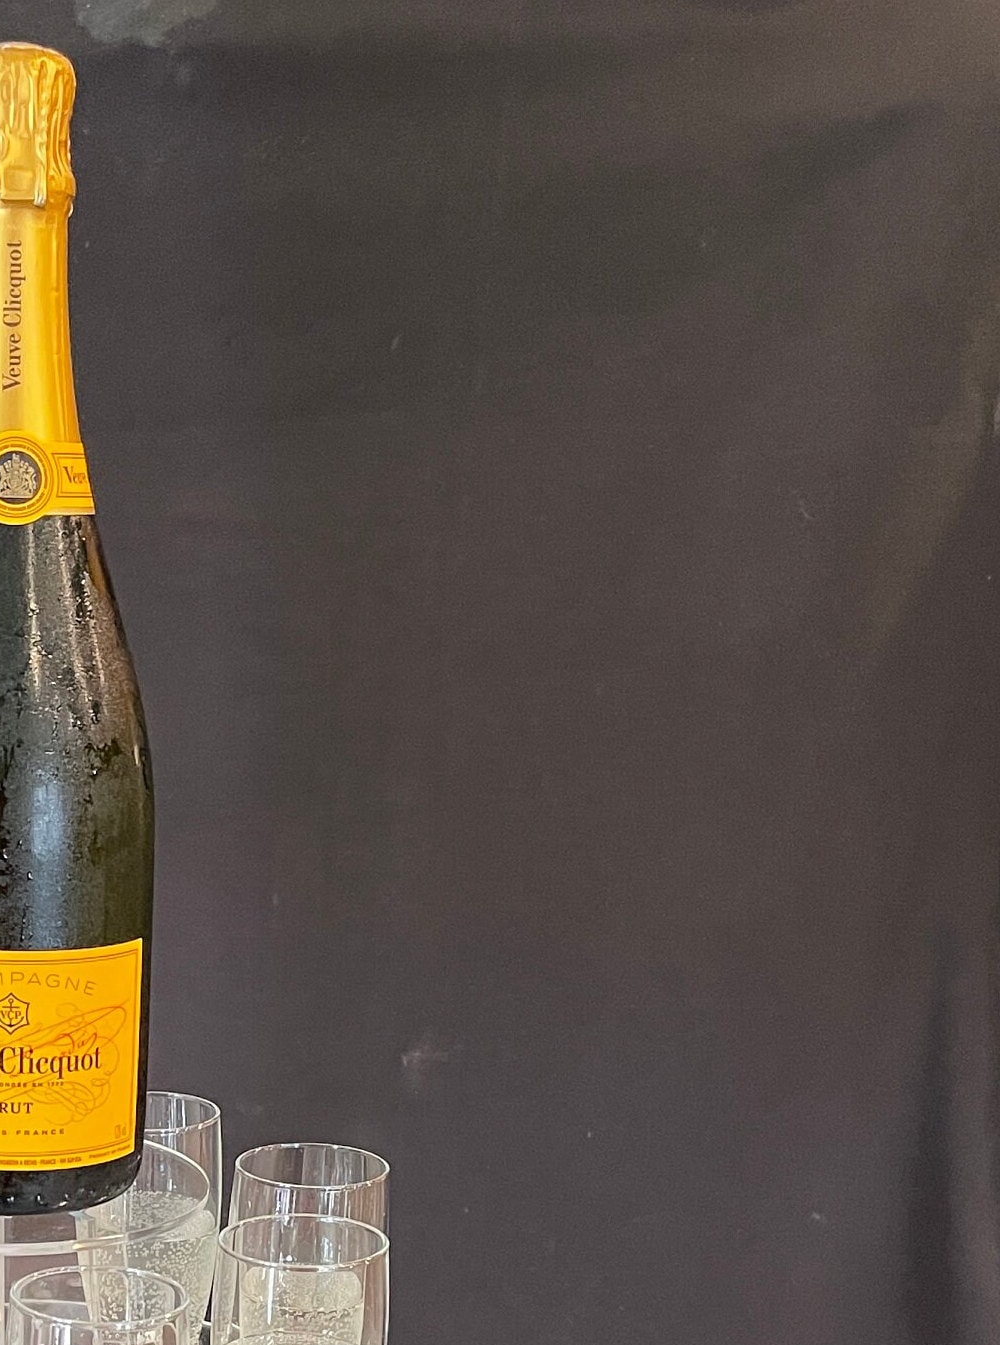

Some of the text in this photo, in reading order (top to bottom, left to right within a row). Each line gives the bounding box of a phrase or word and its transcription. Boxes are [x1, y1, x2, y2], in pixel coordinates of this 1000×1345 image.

[1, 240, 27, 392] Veuve Clicquot
[0, 1010, 22, 1020] VCP
[16, 1128, 65, 1136] FRANCE
